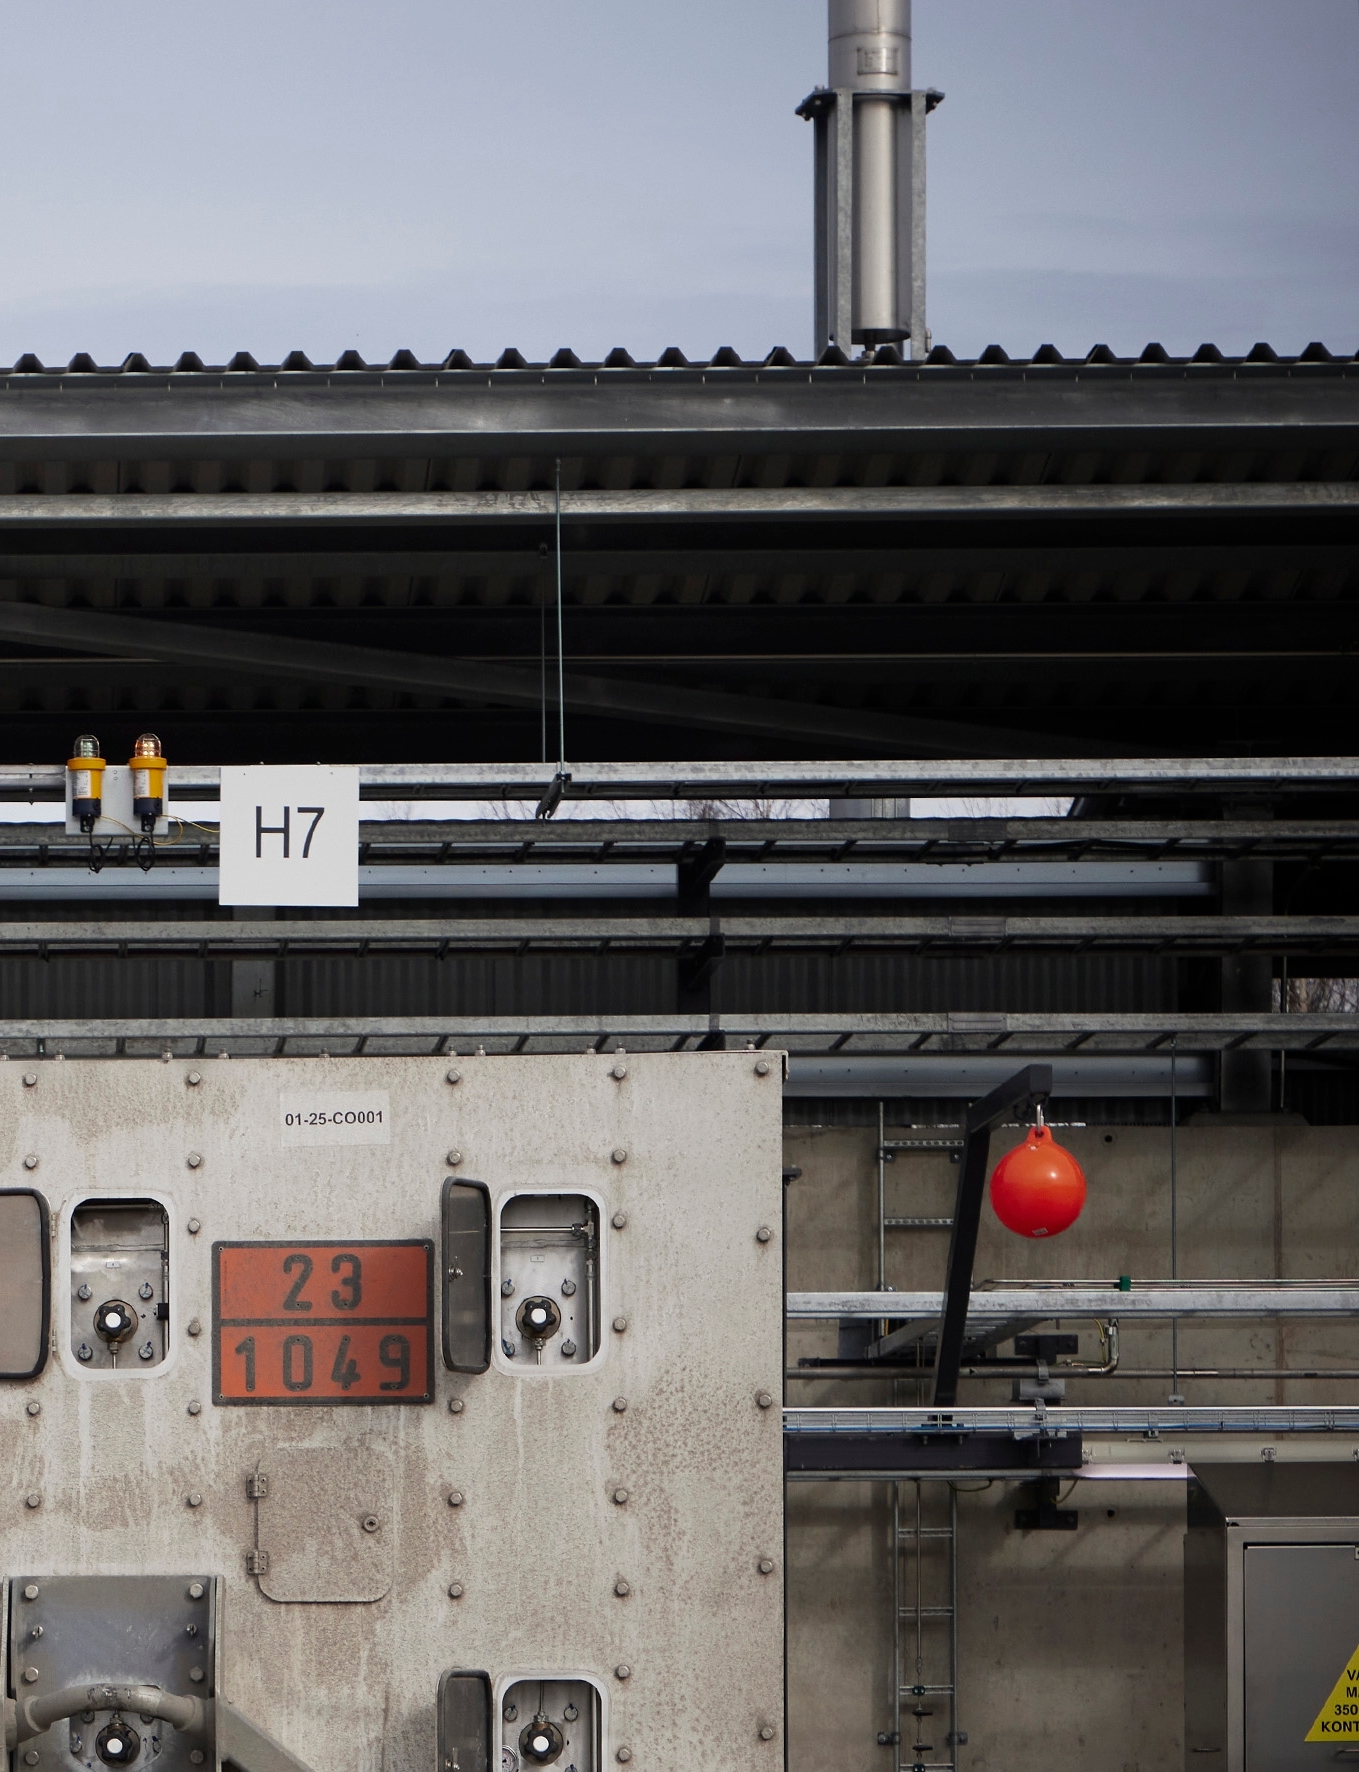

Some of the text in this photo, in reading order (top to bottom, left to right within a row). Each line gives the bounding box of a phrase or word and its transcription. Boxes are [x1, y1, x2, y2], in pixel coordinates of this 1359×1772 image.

[255, 805, 325, 859] H7
[285, 1110, 383, 1126] 01-25-CO001
[283, 1254, 362, 1311] 23
[235, 1335, 410, 1392] 1049
[1334, 1704, 1358, 1715] 350
[1346, 1687, 1359, 1698] M
